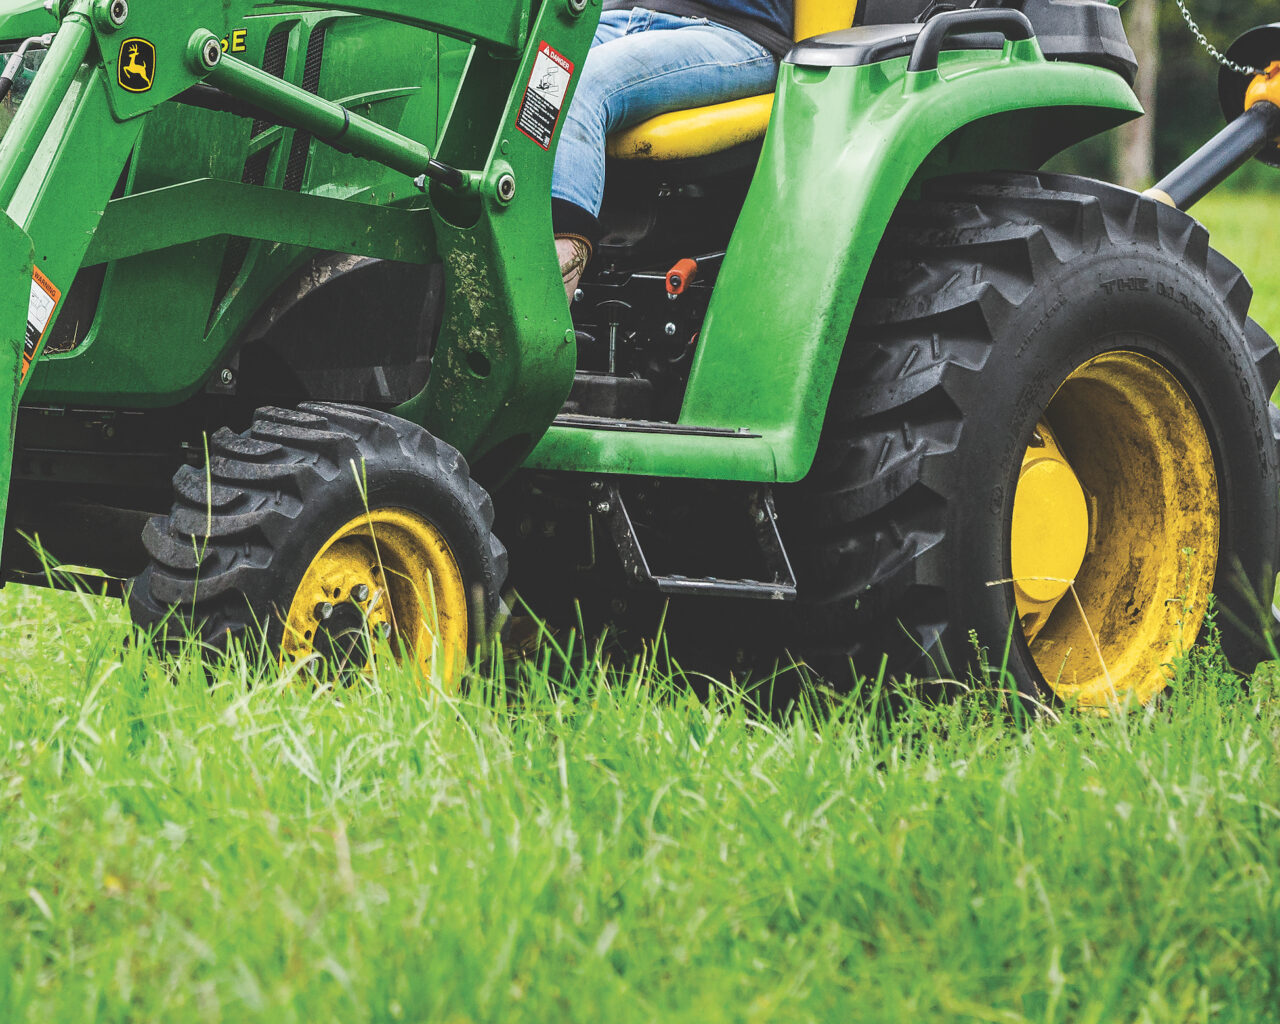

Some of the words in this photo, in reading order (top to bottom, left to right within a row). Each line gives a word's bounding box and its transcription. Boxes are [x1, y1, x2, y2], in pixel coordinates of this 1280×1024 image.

[550, 50, 570, 72] DANGER
[34, 271, 57, 297] WARNING
[1099, 278, 1149, 296] THE
